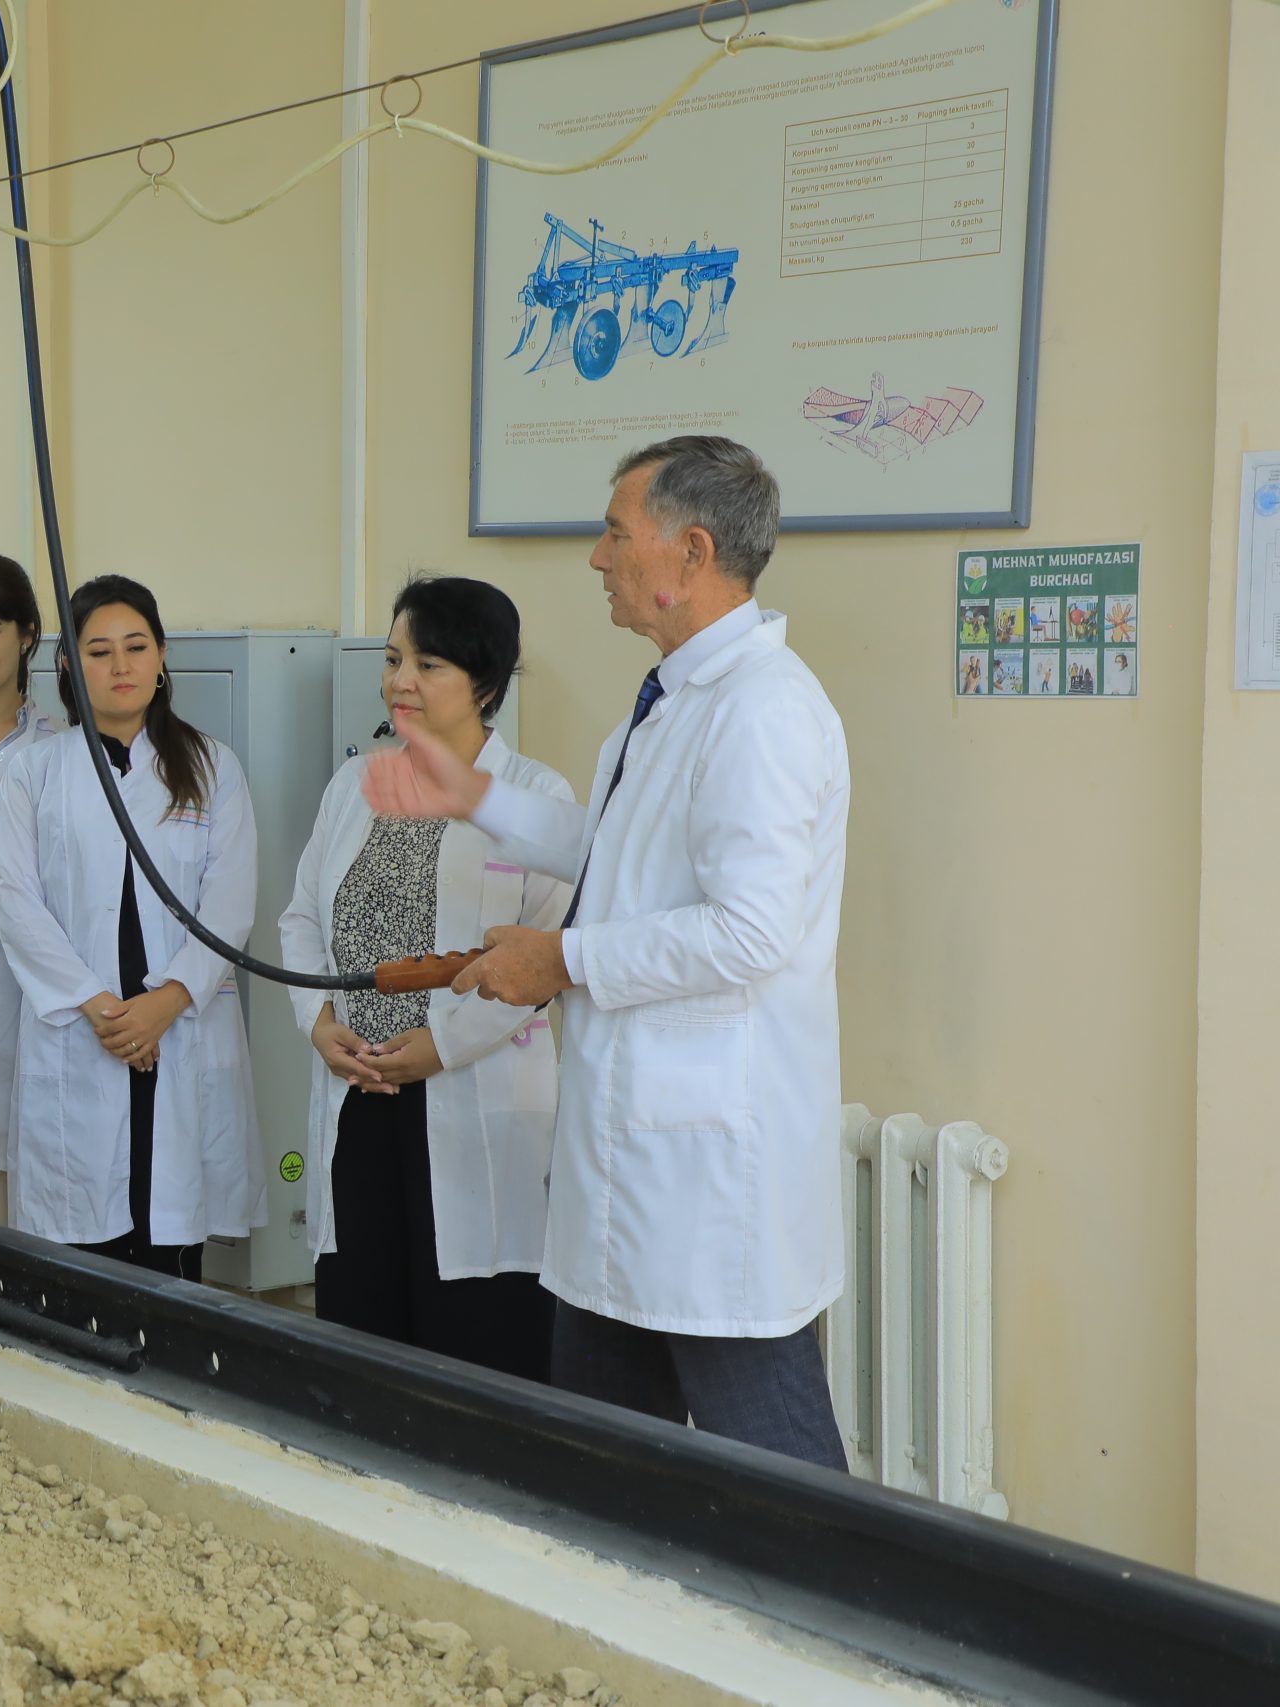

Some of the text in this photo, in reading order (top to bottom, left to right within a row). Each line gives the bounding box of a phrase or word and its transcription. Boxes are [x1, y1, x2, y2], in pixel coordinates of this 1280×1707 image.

[872, 118, 882, 127] PN
[621, 231, 627, 240] 2
[703, 232, 709, 240] 5
[528, 341, 536, 349] 10
[700, 359, 706, 367] 6
[574, 377, 580, 386] 8
[992, 551, 1134, 569] MEHNAT MUHOFAZASI
[1030, 573, 1093, 588] BURCHAGI
